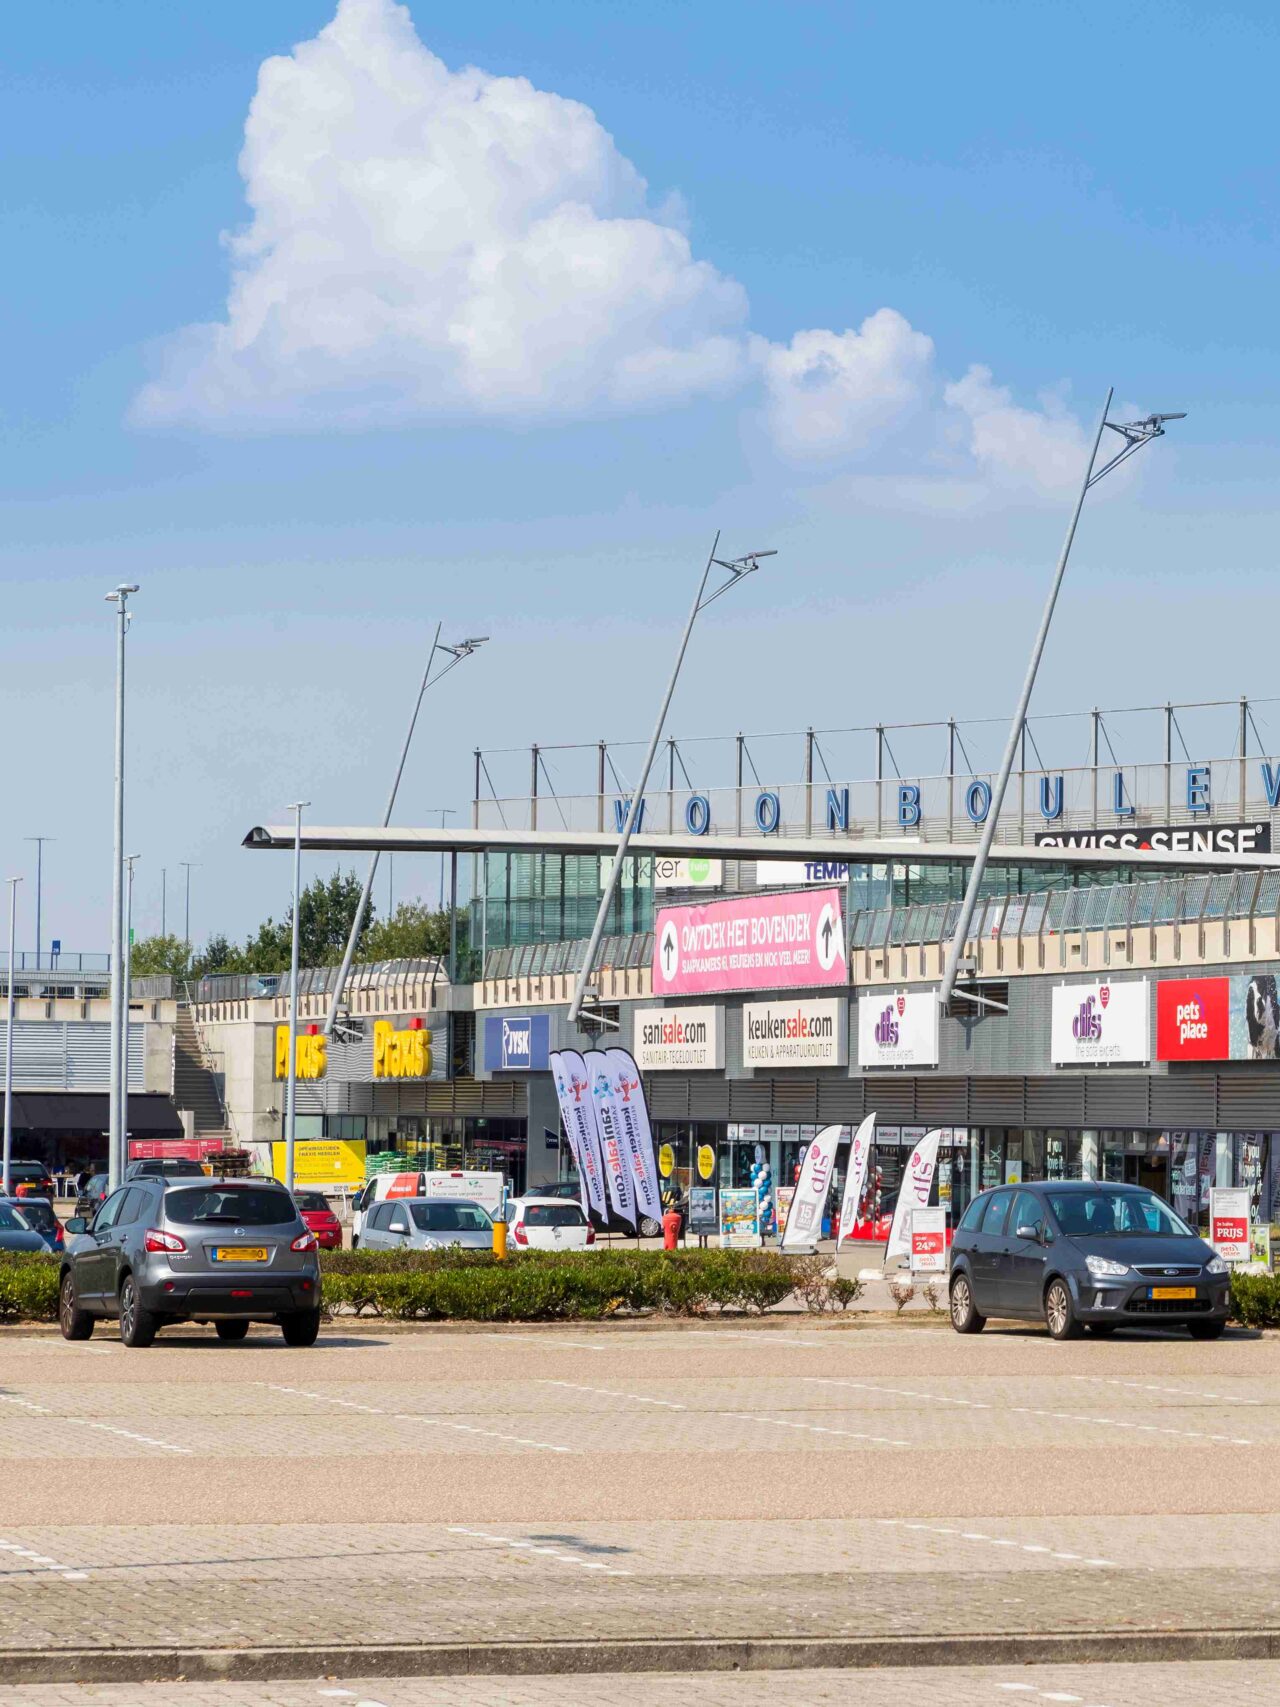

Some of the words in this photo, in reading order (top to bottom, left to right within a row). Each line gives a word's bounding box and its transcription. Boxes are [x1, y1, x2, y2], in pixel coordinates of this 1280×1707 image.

[728, 918, 749, 947] HET
[748, 1009, 832, 1040] keukensale.com
[875, 1004, 899, 1046] dfs
[1072, 995, 1102, 1042] dfs
[1177, 1001, 1199, 1026] pets
[508, 1030, 529, 1054] JYSK
[643, 1014, 706, 1044] sanisale.com
[1180, 1022, 1208, 1045] place
[374, 1018, 433, 1079] Praxis
[1217, 1228, 1243, 1239] PRIJS
